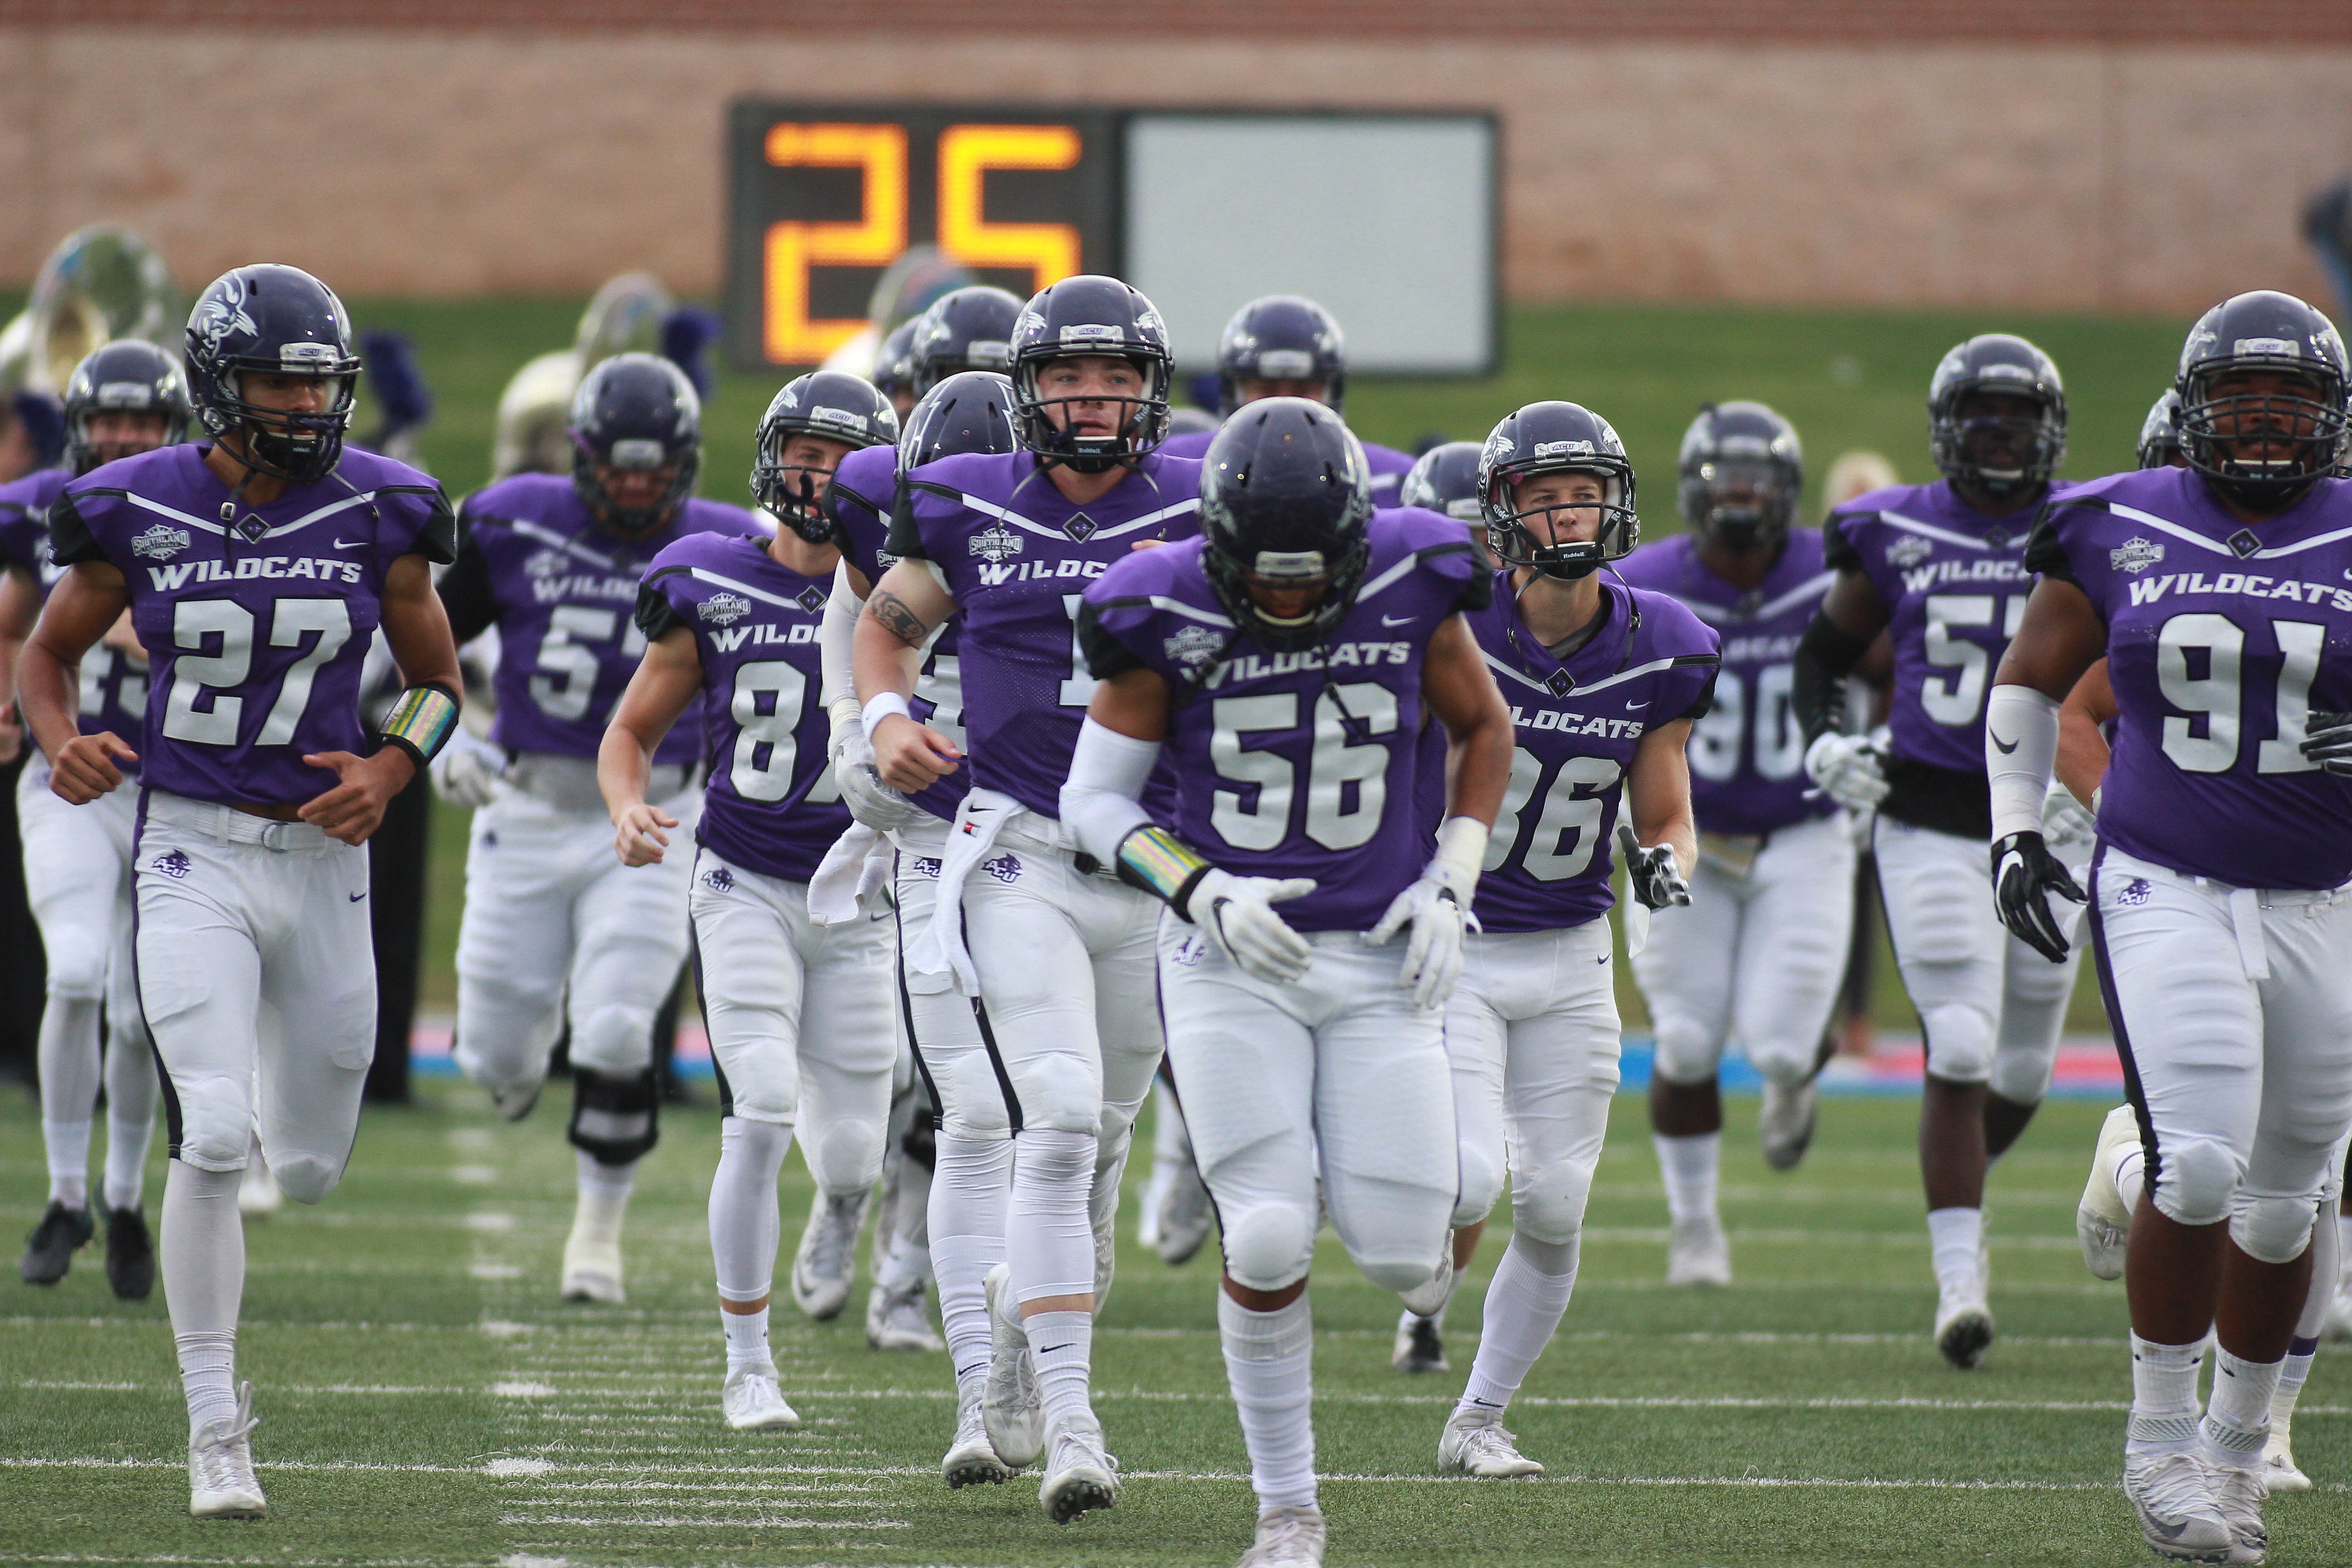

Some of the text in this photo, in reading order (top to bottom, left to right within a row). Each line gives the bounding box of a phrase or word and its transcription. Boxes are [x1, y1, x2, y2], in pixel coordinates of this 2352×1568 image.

[764, 122, 1083, 364] 25
[147, 556, 363, 592] WILDCATS
[2128, 572, 2352, 612] WILDCATS
[162, 598, 353, 746] 27
[1180, 642, 1411, 691] WILDCATS
[2157, 613, 2326, 774] 91
[1504, 705, 1644, 739] LDCATS
[1210, 682, 1398, 851] 56
[152, 857, 188, 878] ACU
[701, 871, 731, 892] ACU
[982, 859, 1019, 883] ACU
[2117, 889, 2149, 905] ACU
